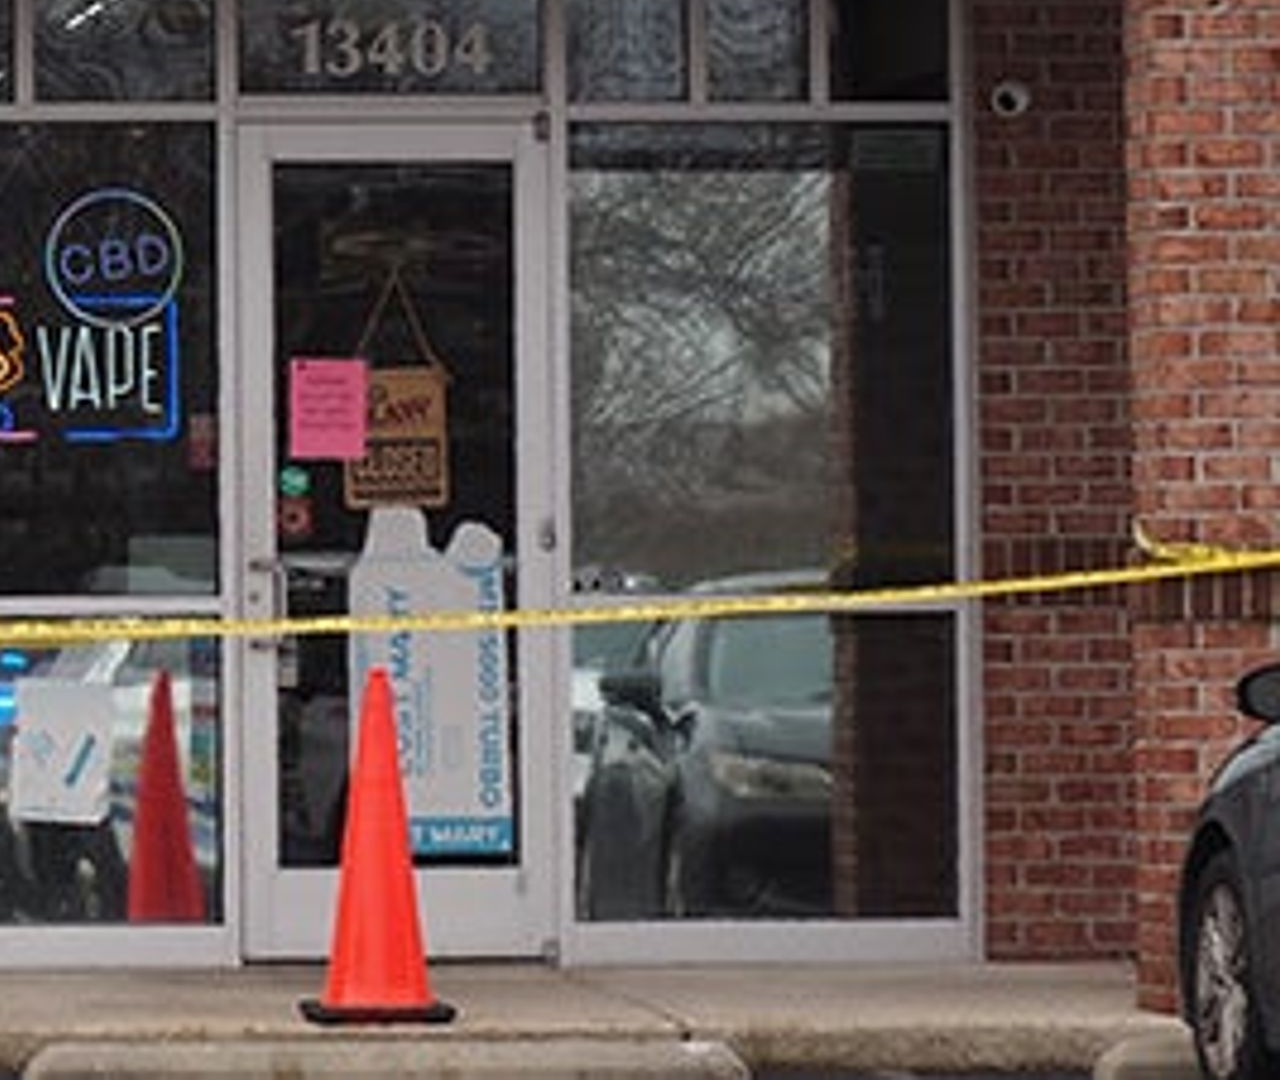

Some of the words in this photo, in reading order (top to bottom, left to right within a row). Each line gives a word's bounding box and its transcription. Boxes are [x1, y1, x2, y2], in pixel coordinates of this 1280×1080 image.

[290, 18, 493, 78] 13404
[60, 233, 169, 284] CBD
[36, 323, 163, 413] VAPE
